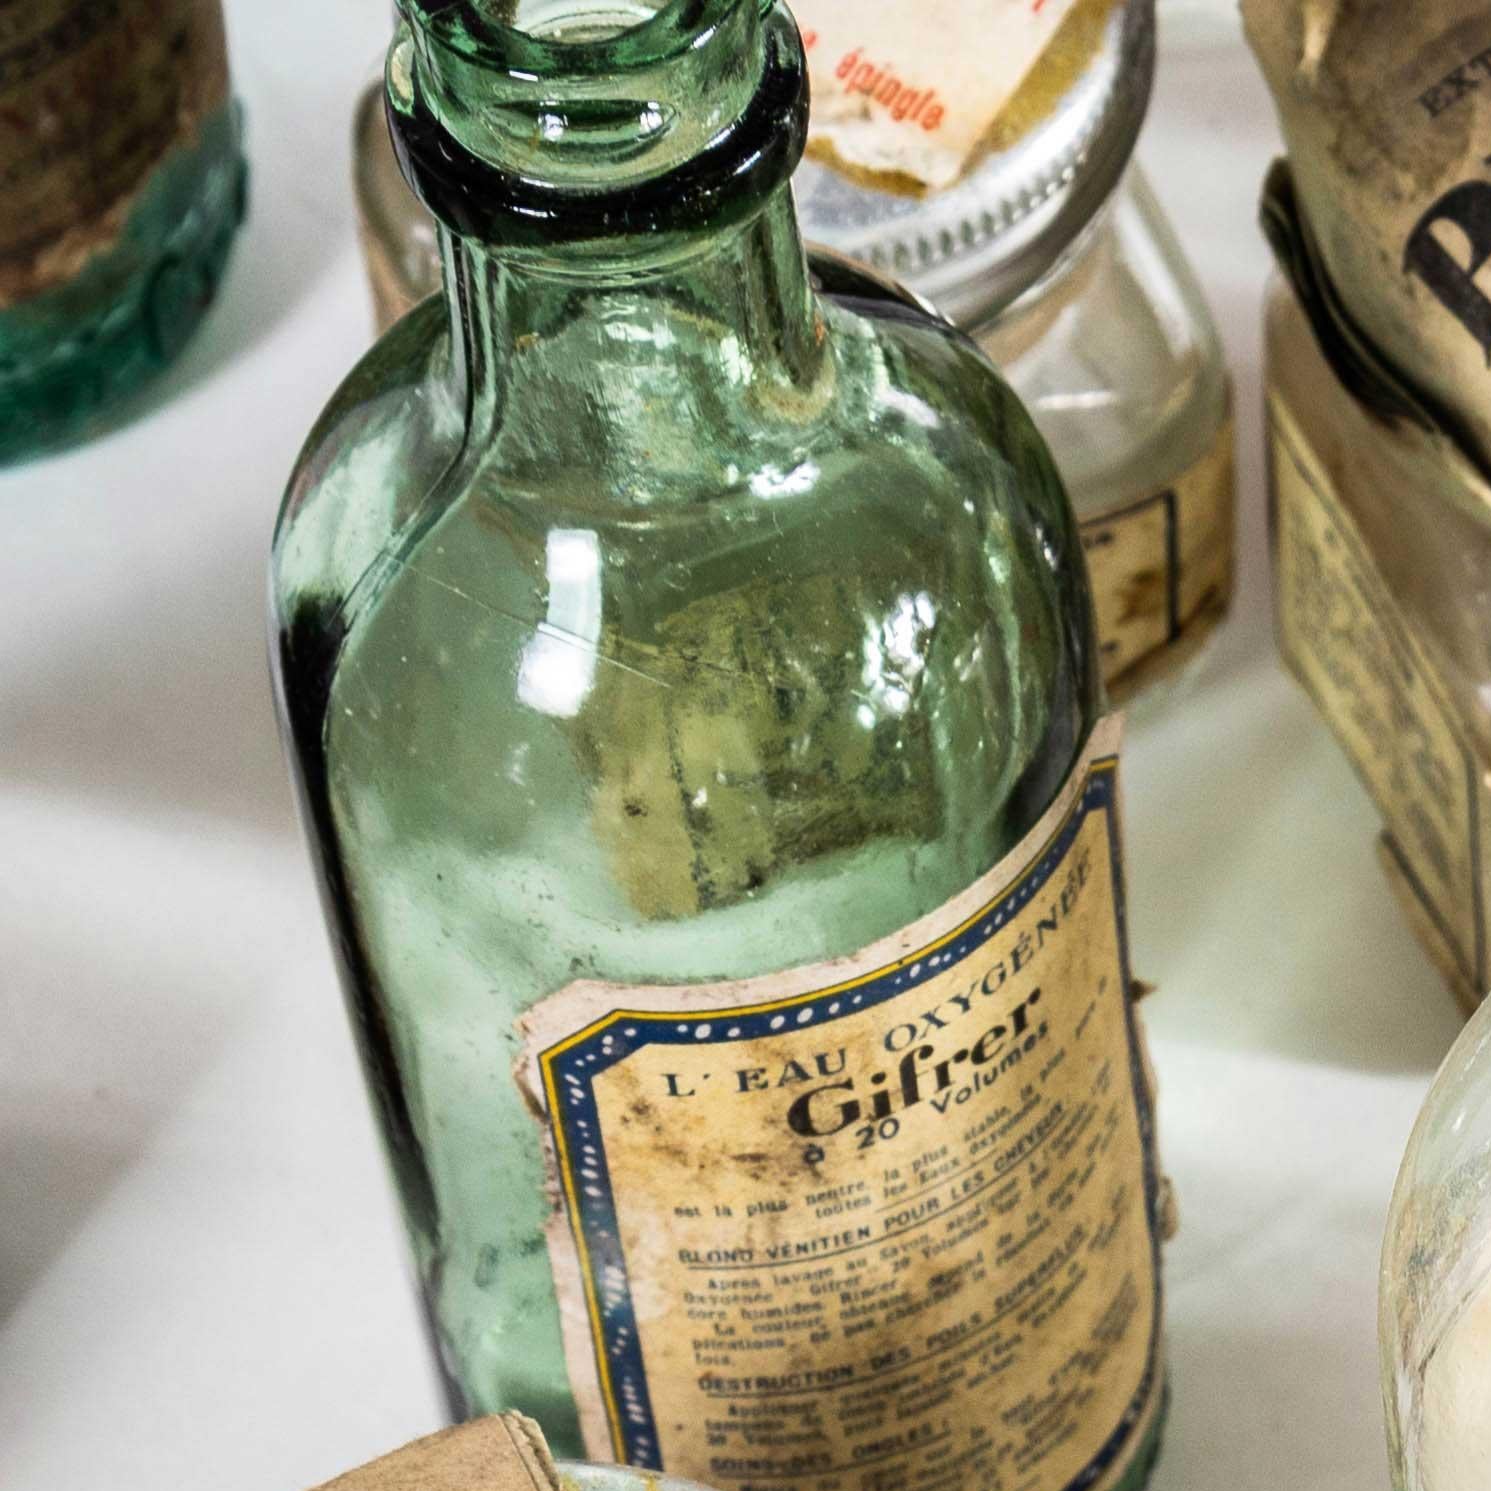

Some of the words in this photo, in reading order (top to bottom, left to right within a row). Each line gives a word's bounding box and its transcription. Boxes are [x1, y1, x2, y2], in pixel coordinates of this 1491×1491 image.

[786, 986, 1042, 1138] Gifrer
[855, 1117, 900, 1151] 20
[764, 1222, 870, 1260] VÉNITIEN
[884, 1193, 939, 1233] POUR
